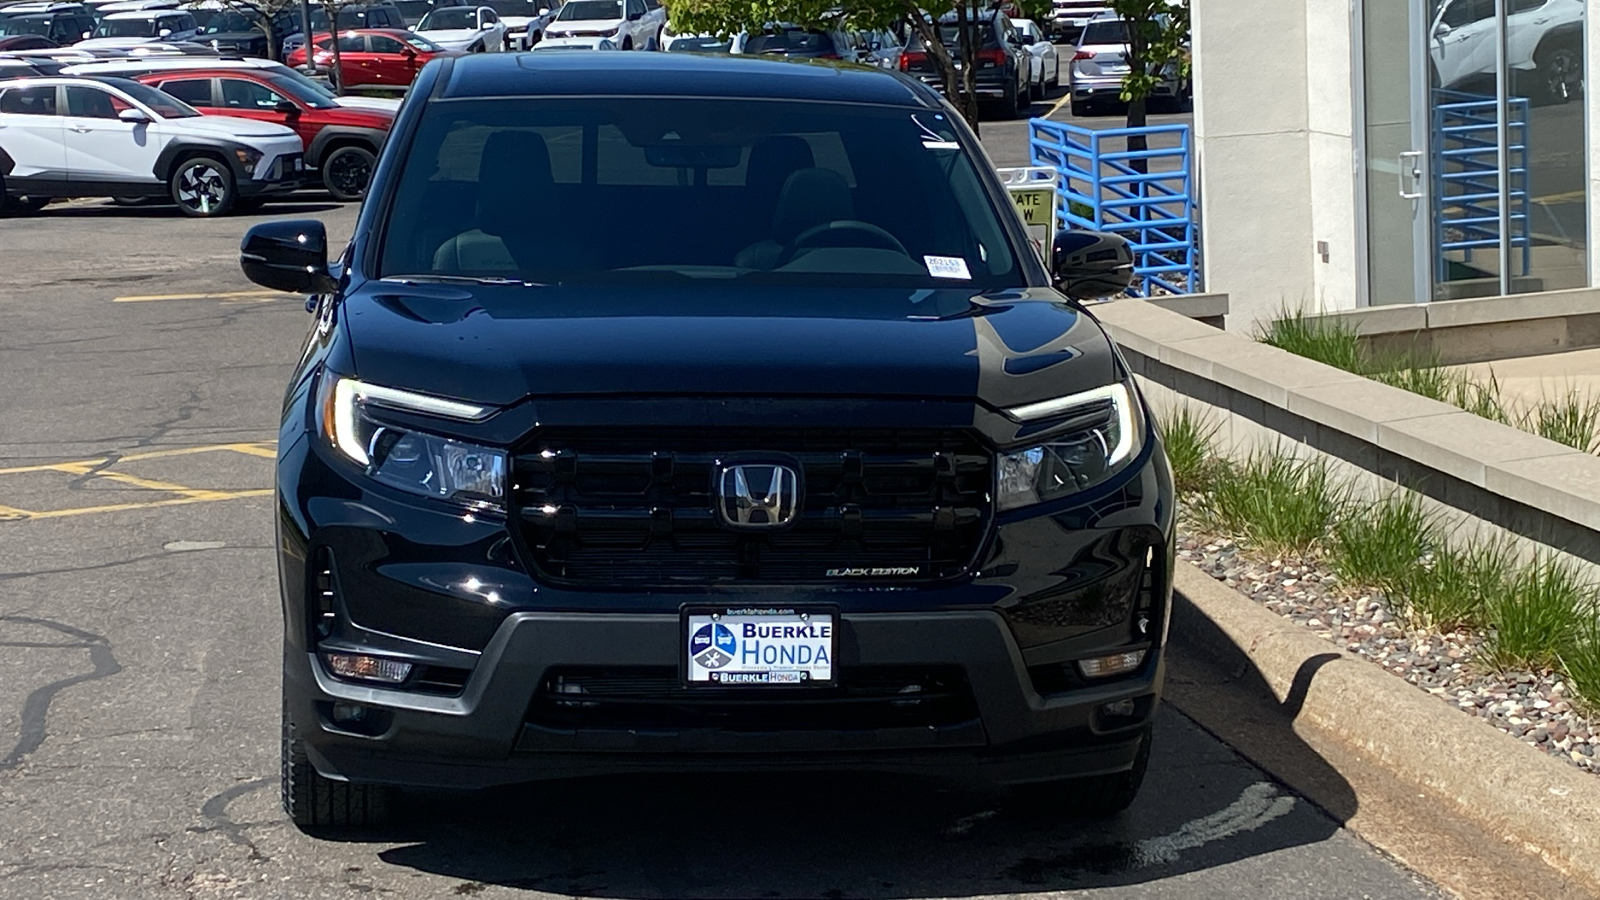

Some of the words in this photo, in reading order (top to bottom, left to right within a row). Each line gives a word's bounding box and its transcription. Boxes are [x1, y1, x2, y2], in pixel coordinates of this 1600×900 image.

[1012, 193, 1041, 206] ATE
[826, 567, 870, 577] BLACK
[871, 566, 920, 576] EDITION
